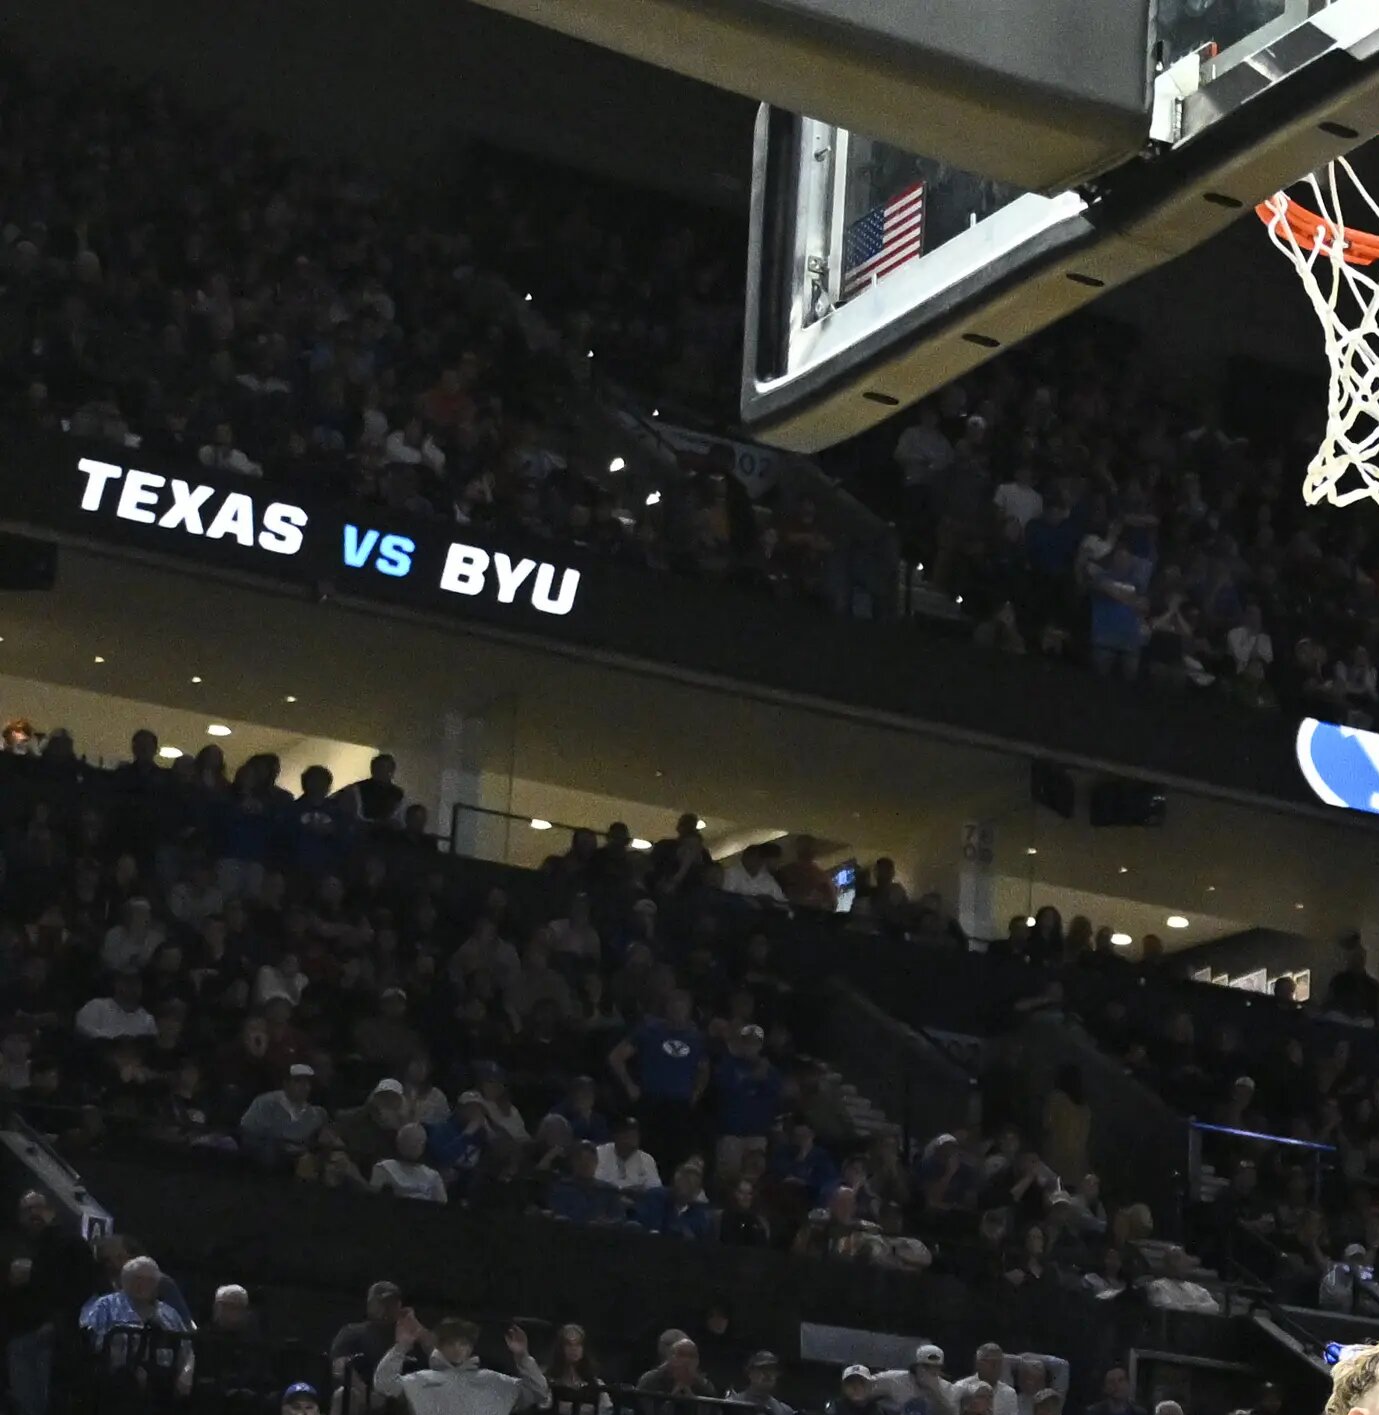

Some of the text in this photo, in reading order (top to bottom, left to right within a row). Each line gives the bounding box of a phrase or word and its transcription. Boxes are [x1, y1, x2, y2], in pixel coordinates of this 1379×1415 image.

[78, 457, 581, 617] TEXAS VS BYU
